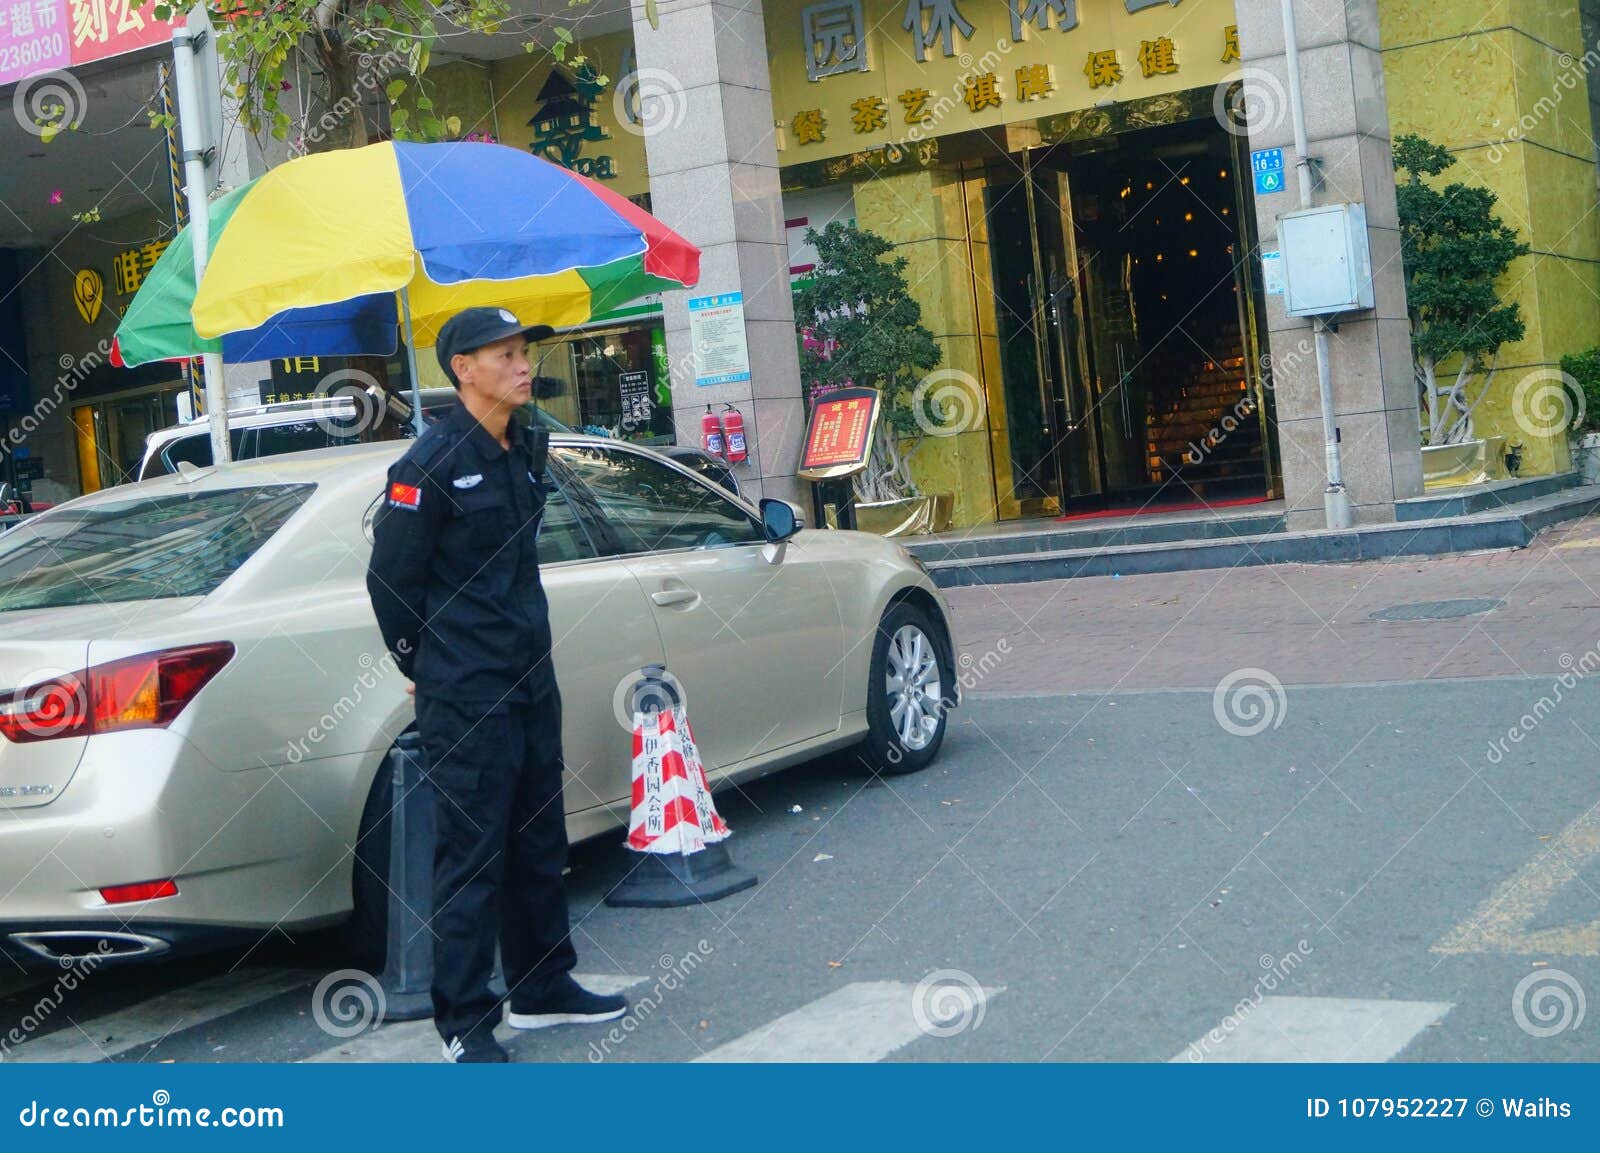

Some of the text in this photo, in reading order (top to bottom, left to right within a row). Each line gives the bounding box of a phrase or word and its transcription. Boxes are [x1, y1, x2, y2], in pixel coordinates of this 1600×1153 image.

[0, 0, 57, 37] 超市
[69, 0, 176, 48] 刻公
[0, 32, 63, 72] 236030
[1084, 36, 1180, 89] 保健
[1265, 174, 1276, 187] A
